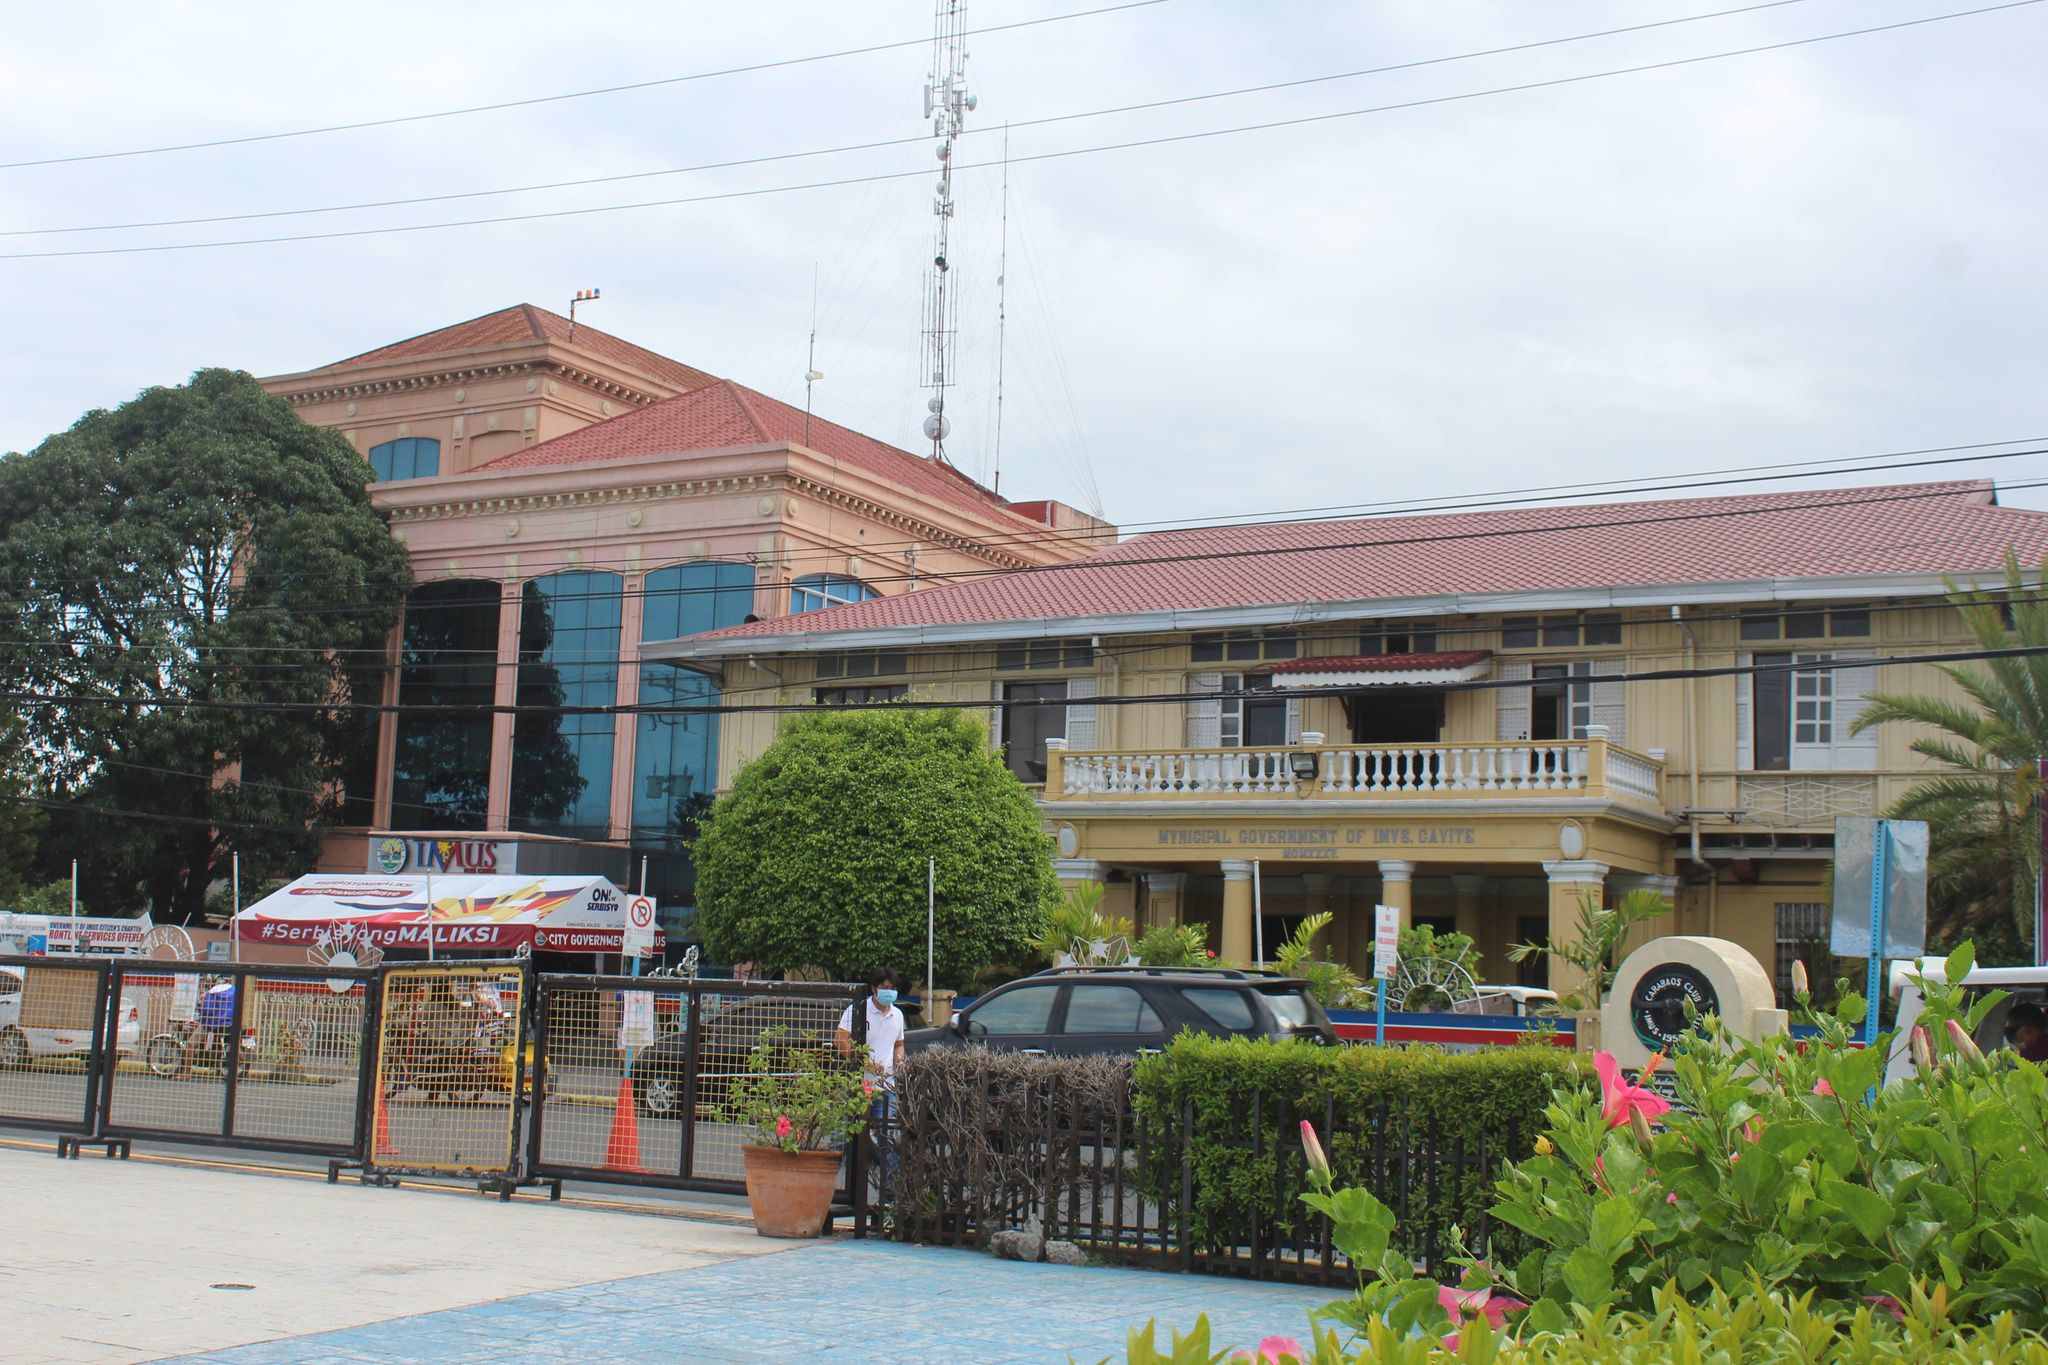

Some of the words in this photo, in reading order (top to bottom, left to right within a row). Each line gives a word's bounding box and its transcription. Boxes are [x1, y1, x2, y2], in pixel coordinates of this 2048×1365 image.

[1158, 829, 1232, 844] MVNICIPAL
[1239, 829, 1338, 844] GOVERNMENT
[1346, 828, 1366, 844] OF
[1418, 828, 1475, 844] CAVITE
[416, 840, 498, 873] IMUS
[587, 902, 619, 912] SERBISYO
[549, 934, 569, 945] CITY
[570, 934, 624, 947] GOVERNMEN
[1645, 977, 1682, 1001] CARABAOS
[1683, 982, 1702, 1003] CLUB
[1643, 1014, 1660, 1035] IMUS
[1662, 1033, 1685, 1043] 195
